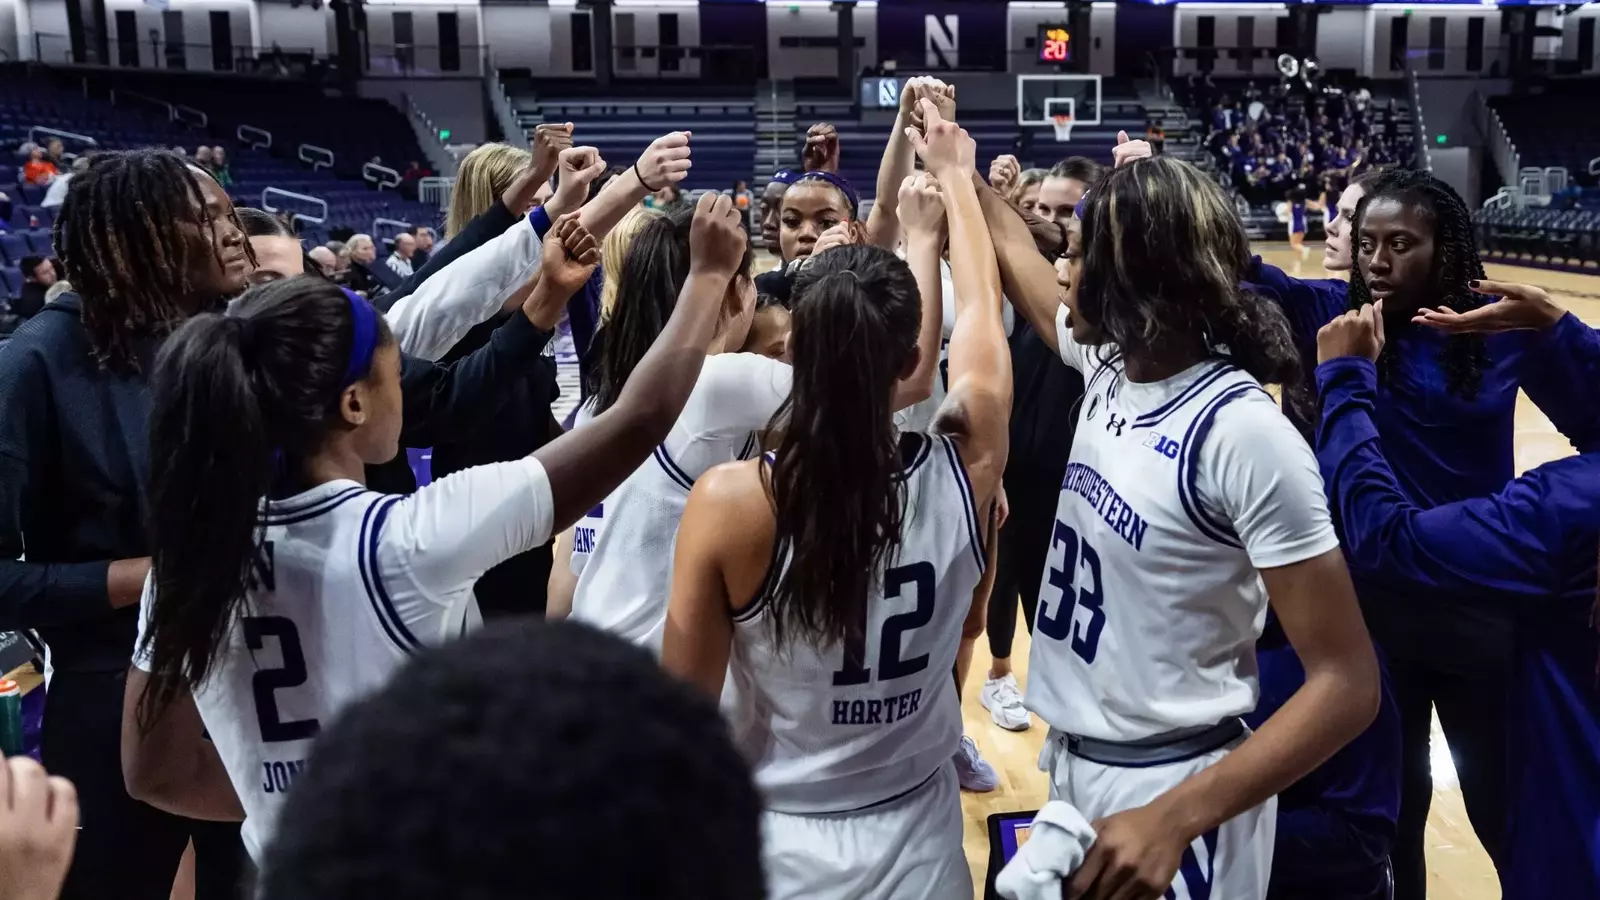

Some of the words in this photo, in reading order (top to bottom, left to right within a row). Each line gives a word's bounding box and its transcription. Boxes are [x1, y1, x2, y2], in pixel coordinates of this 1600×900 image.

[924, 14, 959, 69] N
[1044, 40, 1067, 60] 20
[879, 78, 898, 106] N
[1037, 518, 1106, 665] 33
[832, 561, 936, 686] 12
[242, 615, 322, 743] 2
[832, 688, 923, 725] HARTER
